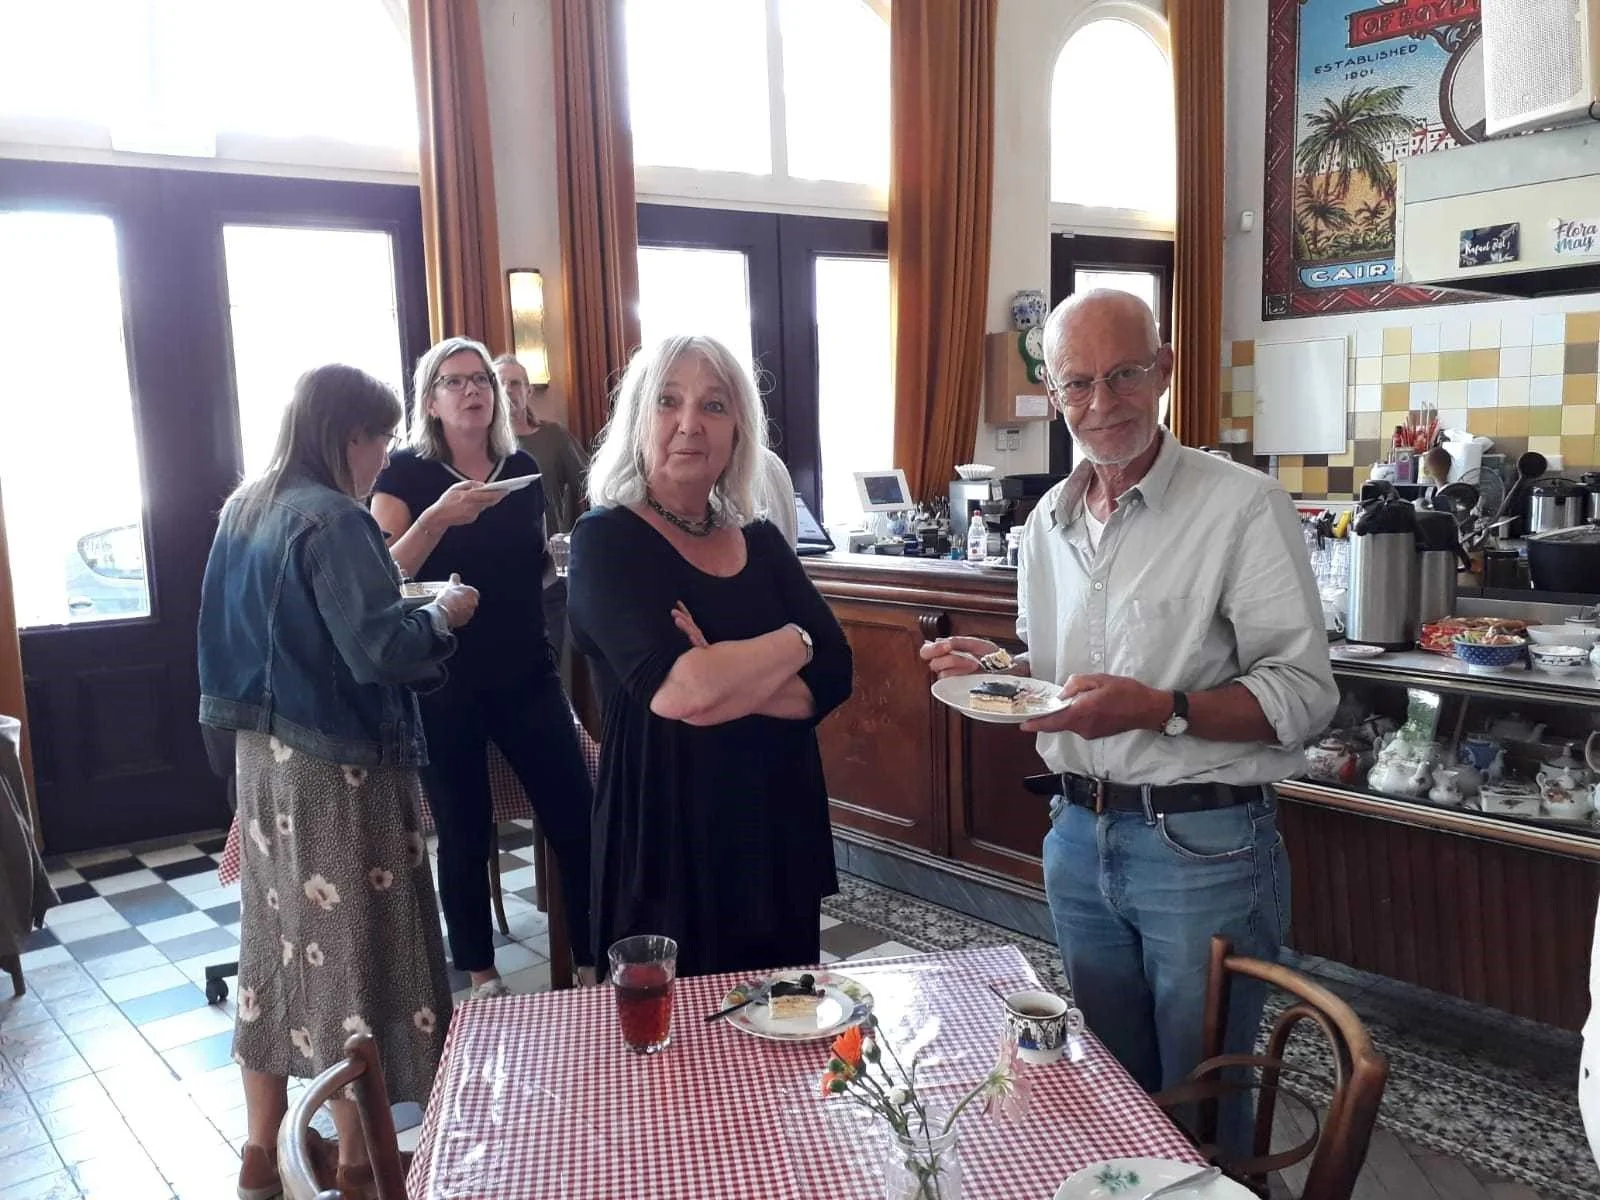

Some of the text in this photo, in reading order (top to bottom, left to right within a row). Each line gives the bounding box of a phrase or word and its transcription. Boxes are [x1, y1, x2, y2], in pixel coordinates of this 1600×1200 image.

[1363, 13, 1394, 37] OF
[1314, 44, 1418, 75] ESTABLISHED
[1555, 219, 1597, 239] Flora
[1310, 263, 1396, 282] CAIR
